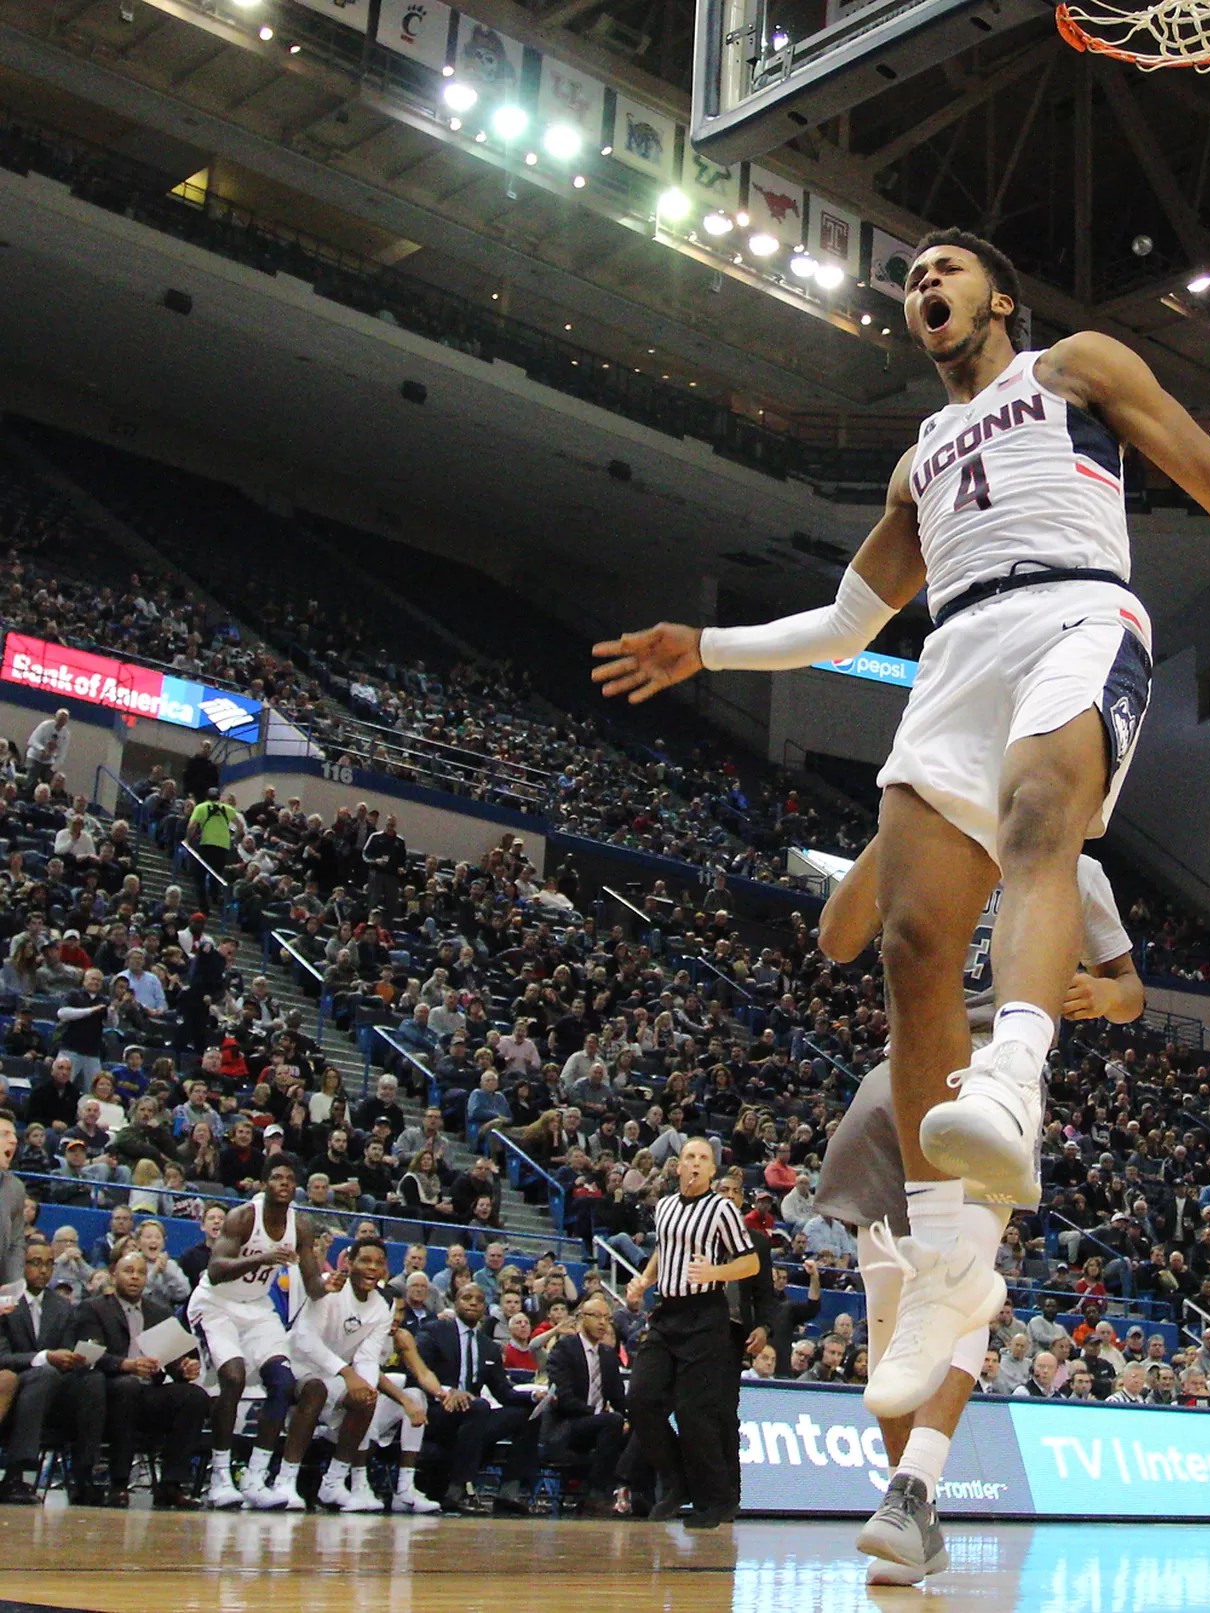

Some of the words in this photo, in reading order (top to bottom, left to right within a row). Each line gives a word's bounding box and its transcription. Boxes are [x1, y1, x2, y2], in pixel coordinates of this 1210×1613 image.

[912, 393, 1047, 499] UCONN
[953, 452, 993, 513] 4
[11, 653, 74, 692] Bank
[74, 673, 103, 700] of
[99, 676, 194, 725] America
[856, 657, 907, 679] pepsi
[321, 762, 353, 785] 116
[1040, 1436, 1103, 1480] TV
